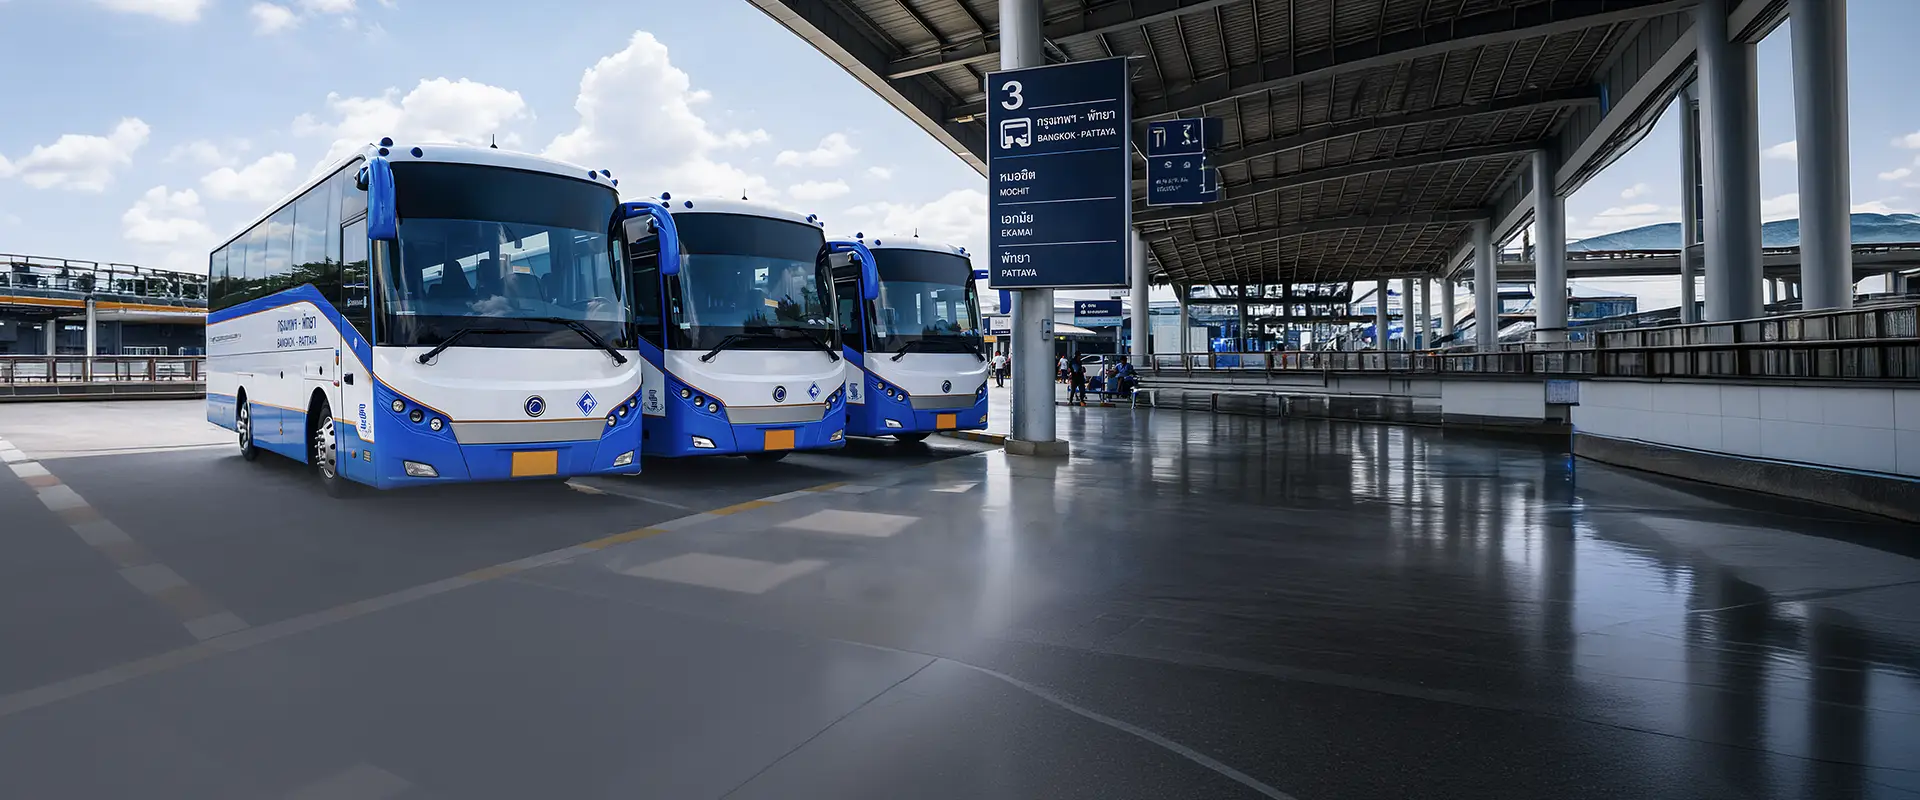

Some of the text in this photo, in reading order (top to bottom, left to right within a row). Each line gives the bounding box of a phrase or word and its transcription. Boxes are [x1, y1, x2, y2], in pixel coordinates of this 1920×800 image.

[1001, 80, 1024, 110] 3
[1087, 108, 1116, 122] พัทยา
[1037, 131, 1077, 142] BANGKOK
[1080, 127, 1117, 138] PATTAYA
[999, 186, 1030, 196] MOCHIT
[1001, 210, 1034, 224] เอกมัย
[1001, 228, 1033, 237] EKAMAI
[1001, 251, 1031, 264] พัทยา
[1001, 268, 1038, 277] PATTAYA
